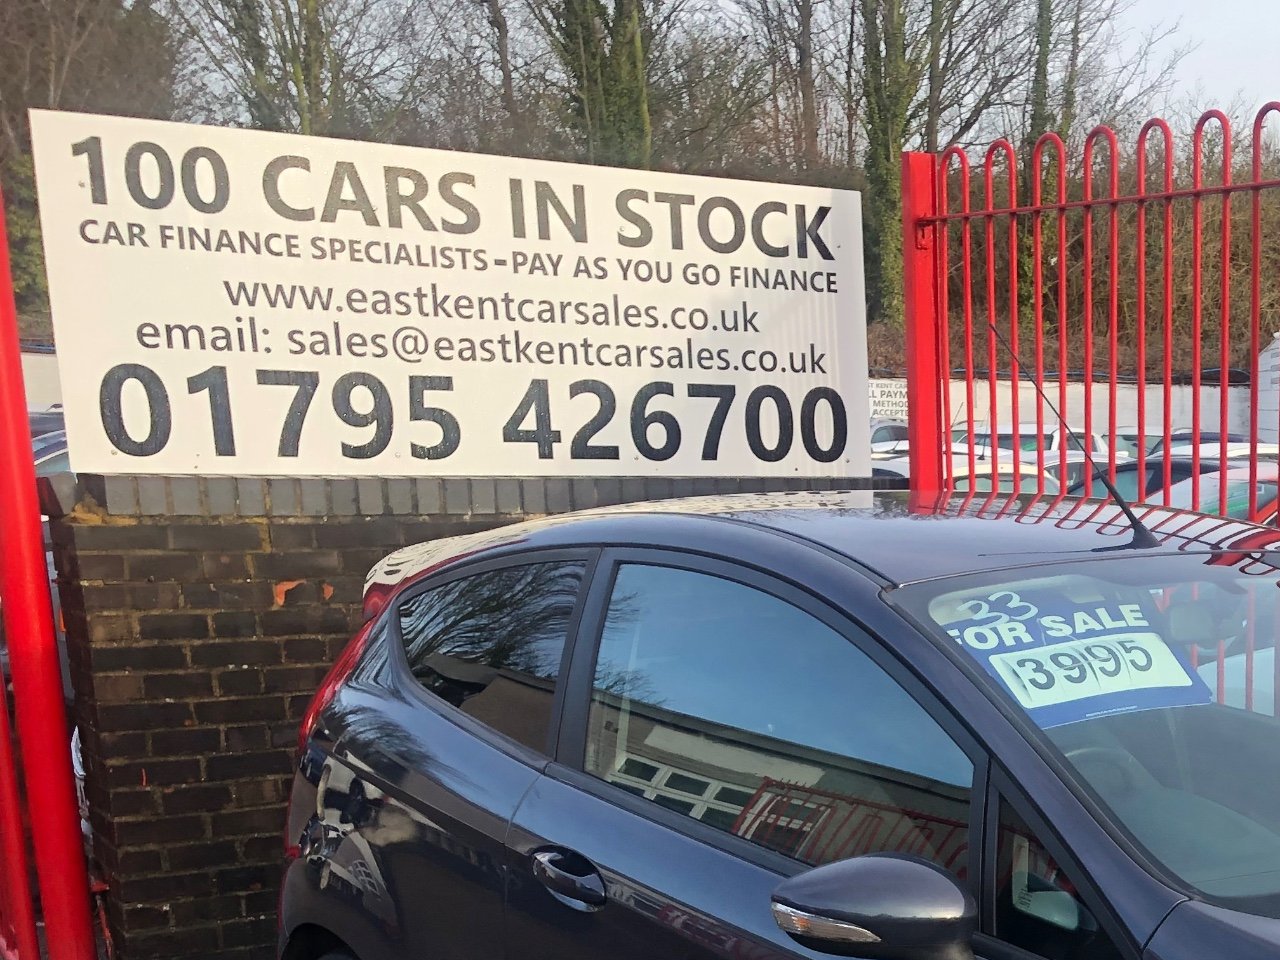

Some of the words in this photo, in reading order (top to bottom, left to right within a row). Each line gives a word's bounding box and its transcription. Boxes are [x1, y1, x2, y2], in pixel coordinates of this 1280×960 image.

[71, 135, 231, 214] 100
[262, 154, 482, 237] CARS
[509, 178, 588, 244] IN
[615, 188, 836, 262] STOCK
[79, 218, 149, 248] CAR
[160, 225, 301, 258] FINANCE
[573, 255, 608, 280] AS
[617, 258, 672, 285] YOU
[682, 263, 721, 287] GO
[730, 266, 838, 293] FINANCE
[223, 279, 760, 334] www.eastkentcarsales.co.uk
[136, 316, 272, 353] email:
[287, 321, 828, 375] sales@eastkentcarsales.co.uk
[99, 363, 462, 459] 01795
[502, 378, 849, 463] 426700
[1036, 604, 1150, 638] SALE
[1016, 640, 1153, 690] 3995
